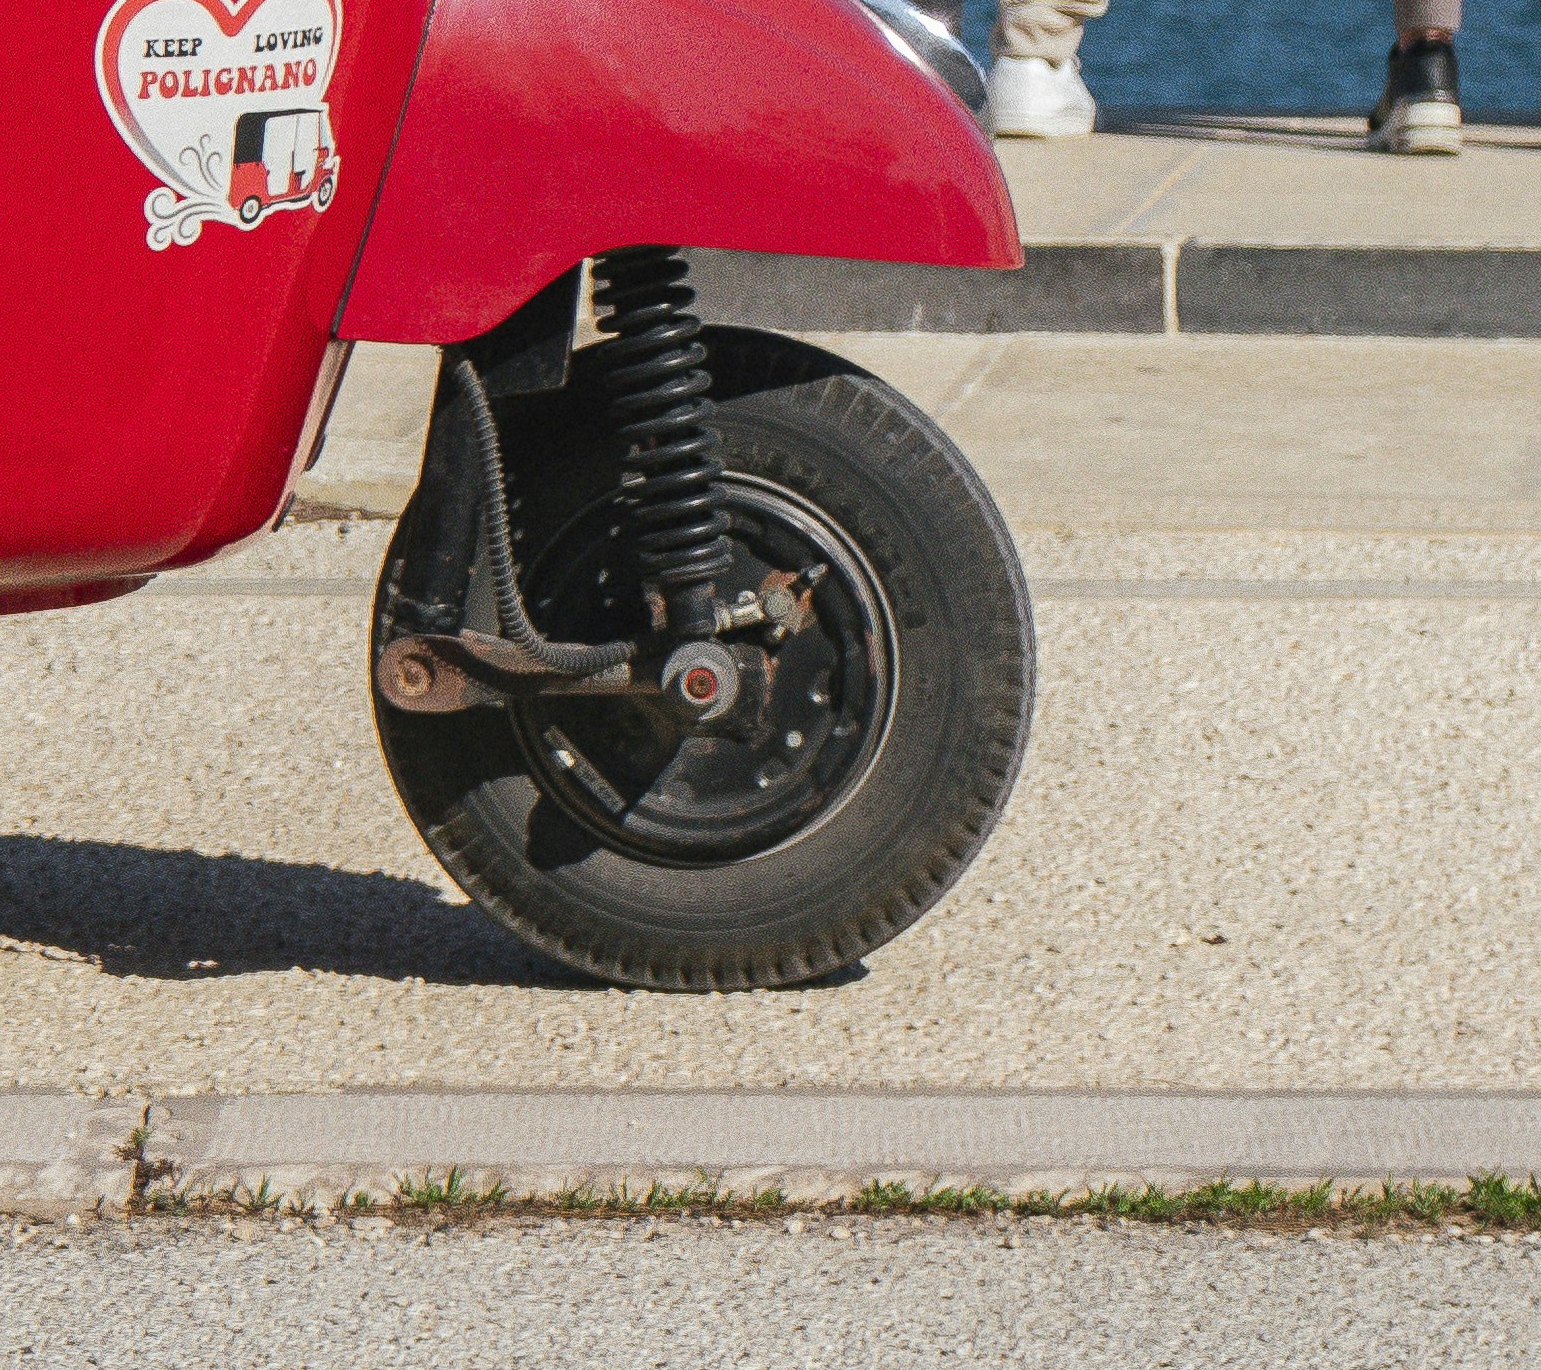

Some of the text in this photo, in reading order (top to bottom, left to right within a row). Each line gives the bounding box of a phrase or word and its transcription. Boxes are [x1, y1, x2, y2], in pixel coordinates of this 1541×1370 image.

[144, 27, 323, 58] KEEP LOVING
[138, 58, 317, 99] POLIGNANO
